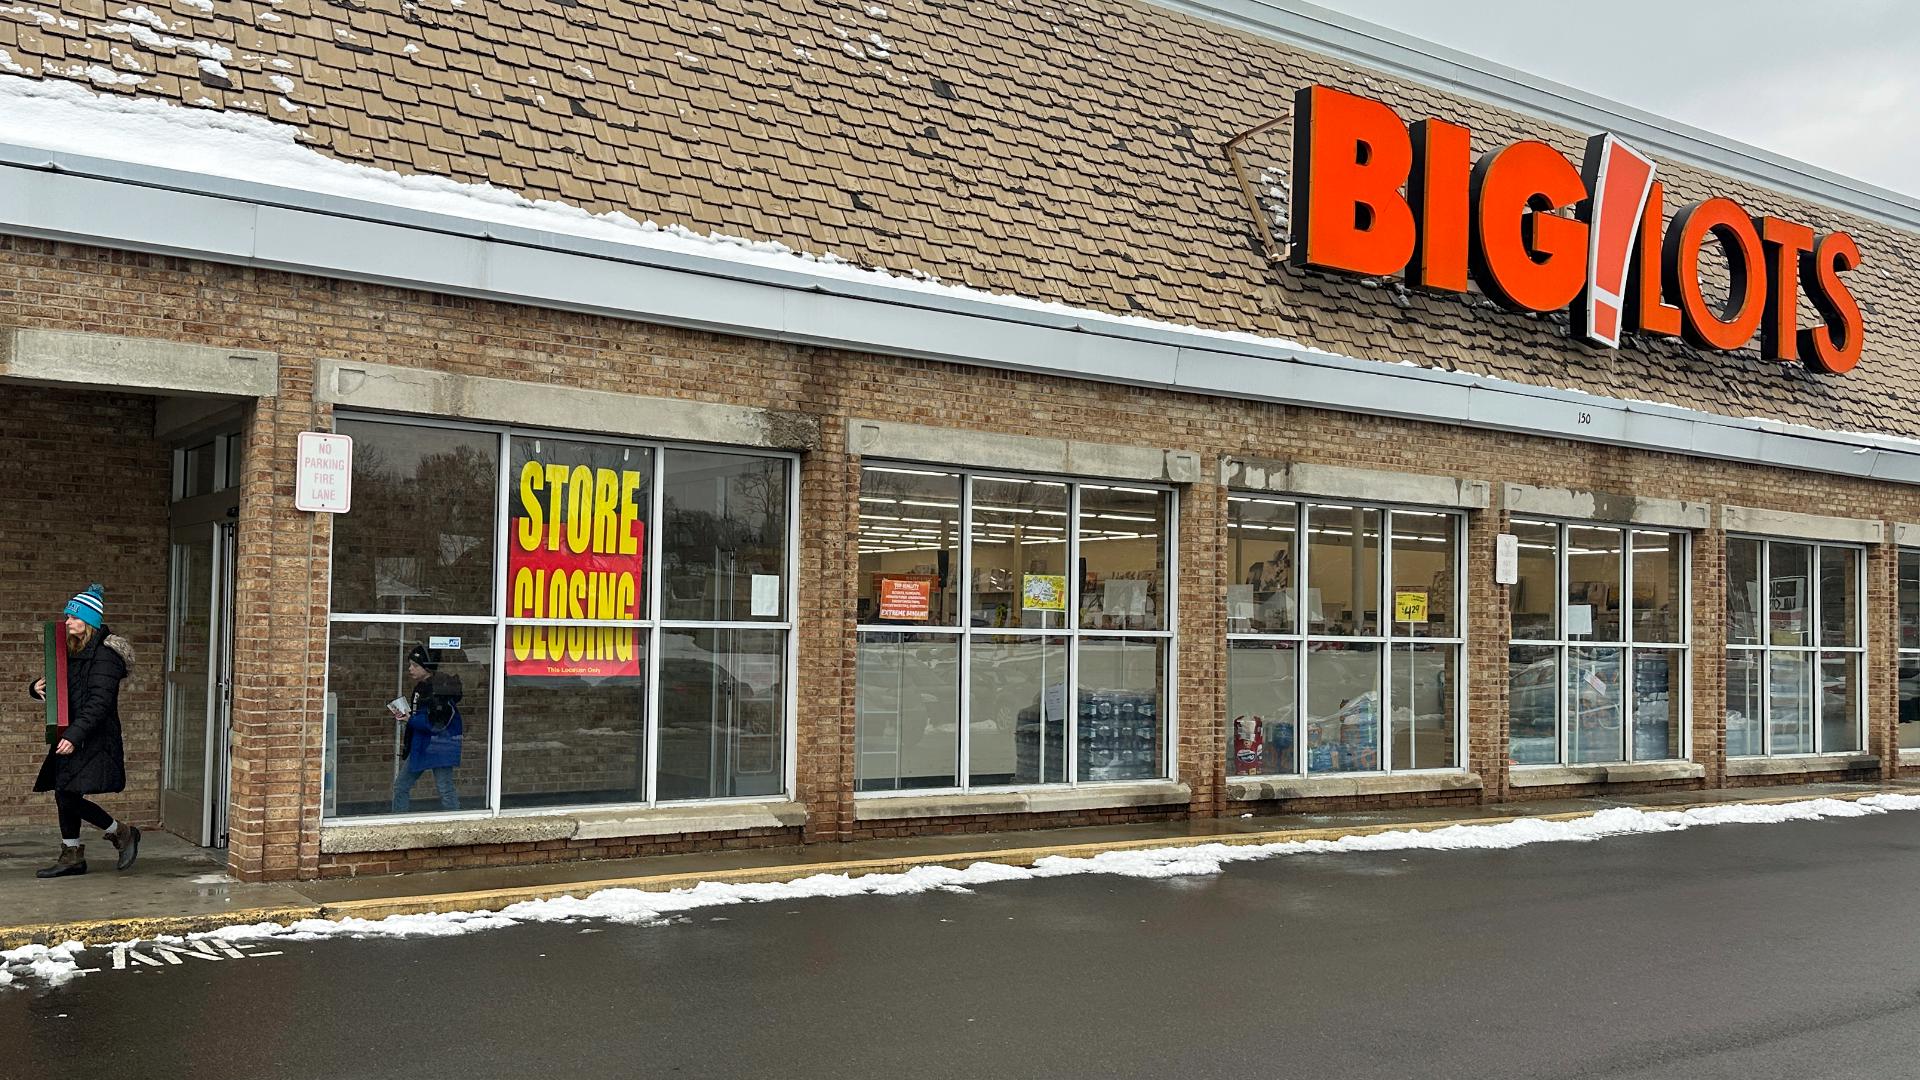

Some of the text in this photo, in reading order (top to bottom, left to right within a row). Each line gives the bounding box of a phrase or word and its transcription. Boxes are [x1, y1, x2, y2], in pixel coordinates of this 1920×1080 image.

[1640, 181, 1864, 373] LOTS
[1578, 411, 1591, 424] 150
[319, 443, 331, 454] NO
[305, 457, 345, 470] PARKING
[314, 473, 335, 485] FIRE
[312, 489, 336, 501] LANE
[518, 460, 641, 555] STORE
[513, 566, 635, 662] CLOSING
[588, 667, 601, 675] Only
